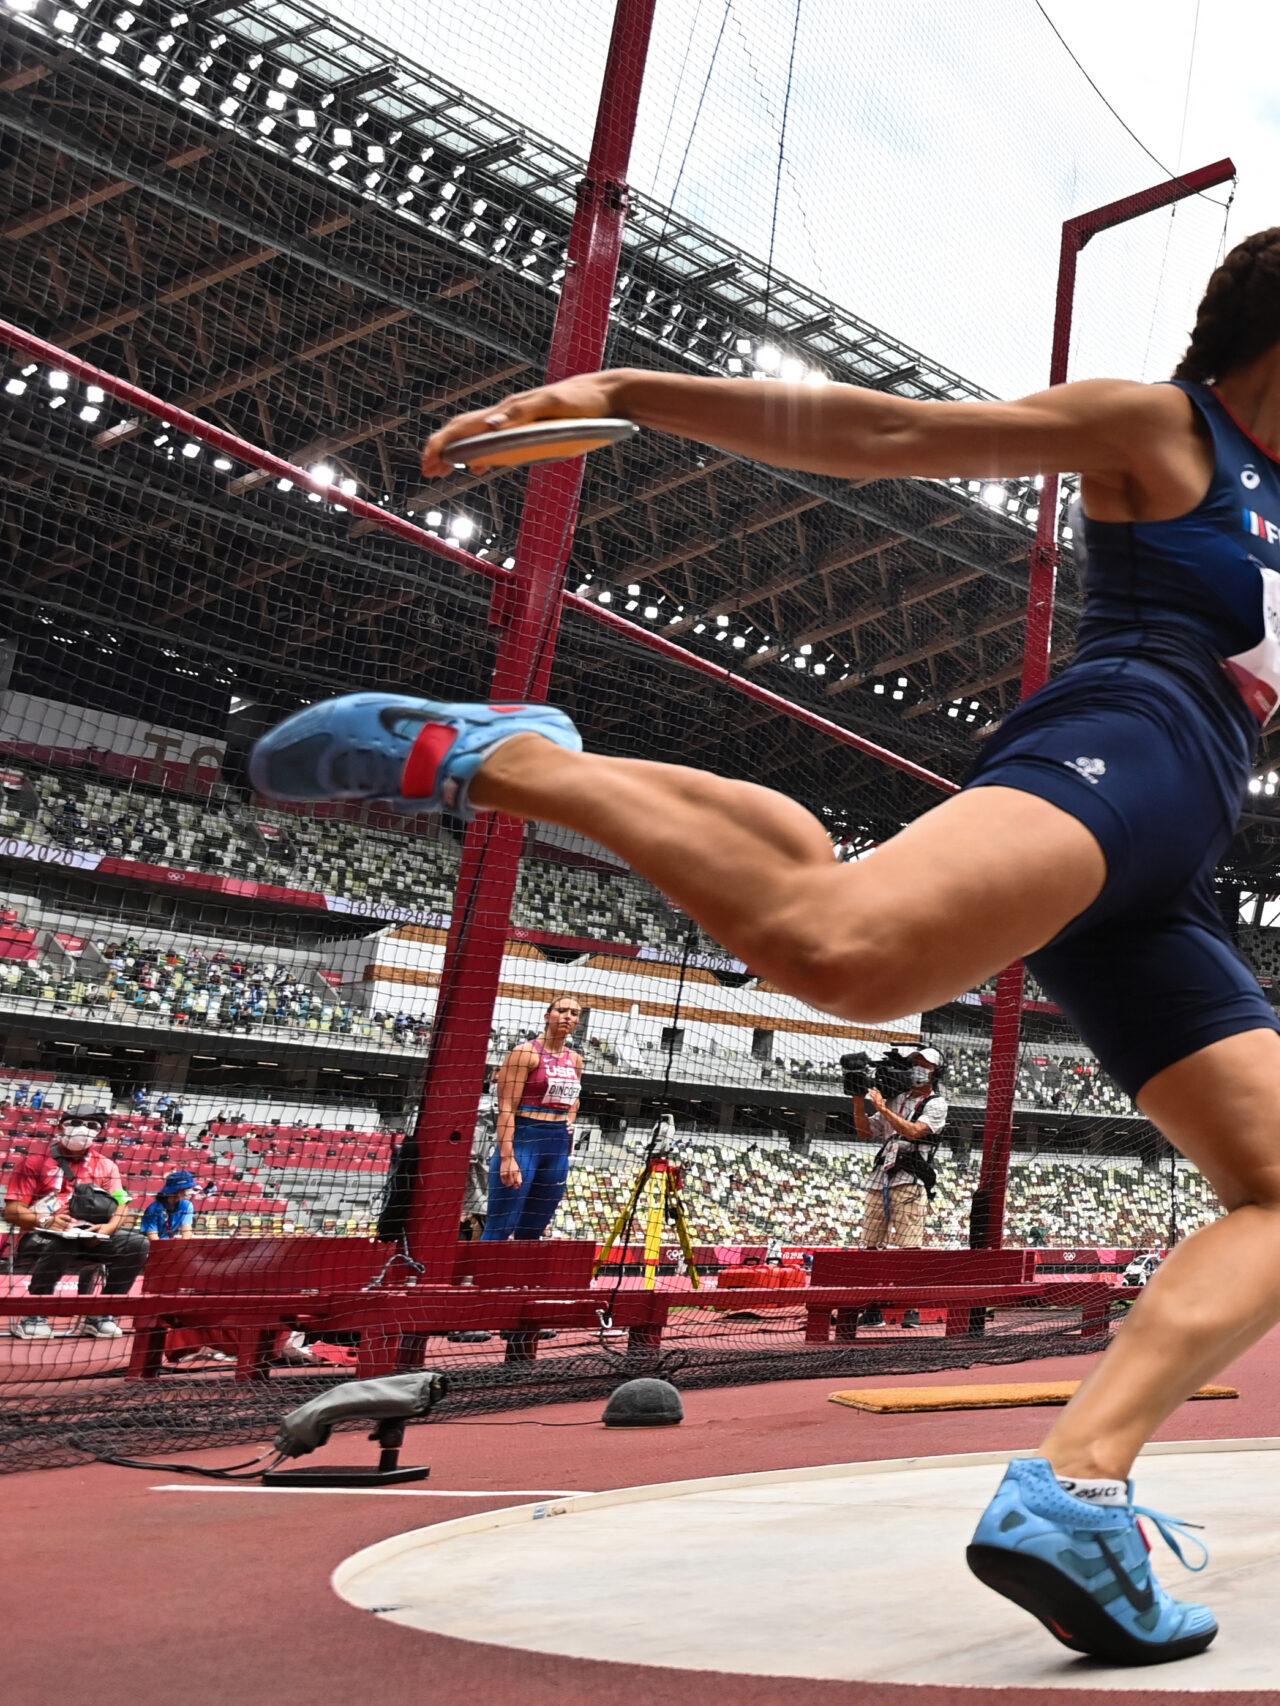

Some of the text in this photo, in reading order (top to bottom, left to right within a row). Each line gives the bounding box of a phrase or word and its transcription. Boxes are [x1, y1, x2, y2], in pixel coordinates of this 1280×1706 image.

[23, 843, 74, 866] 2020
[405, 908, 444, 928] 2020
[700, 956, 732, 971] 2020
[545, 1064, 578, 1079] USA
